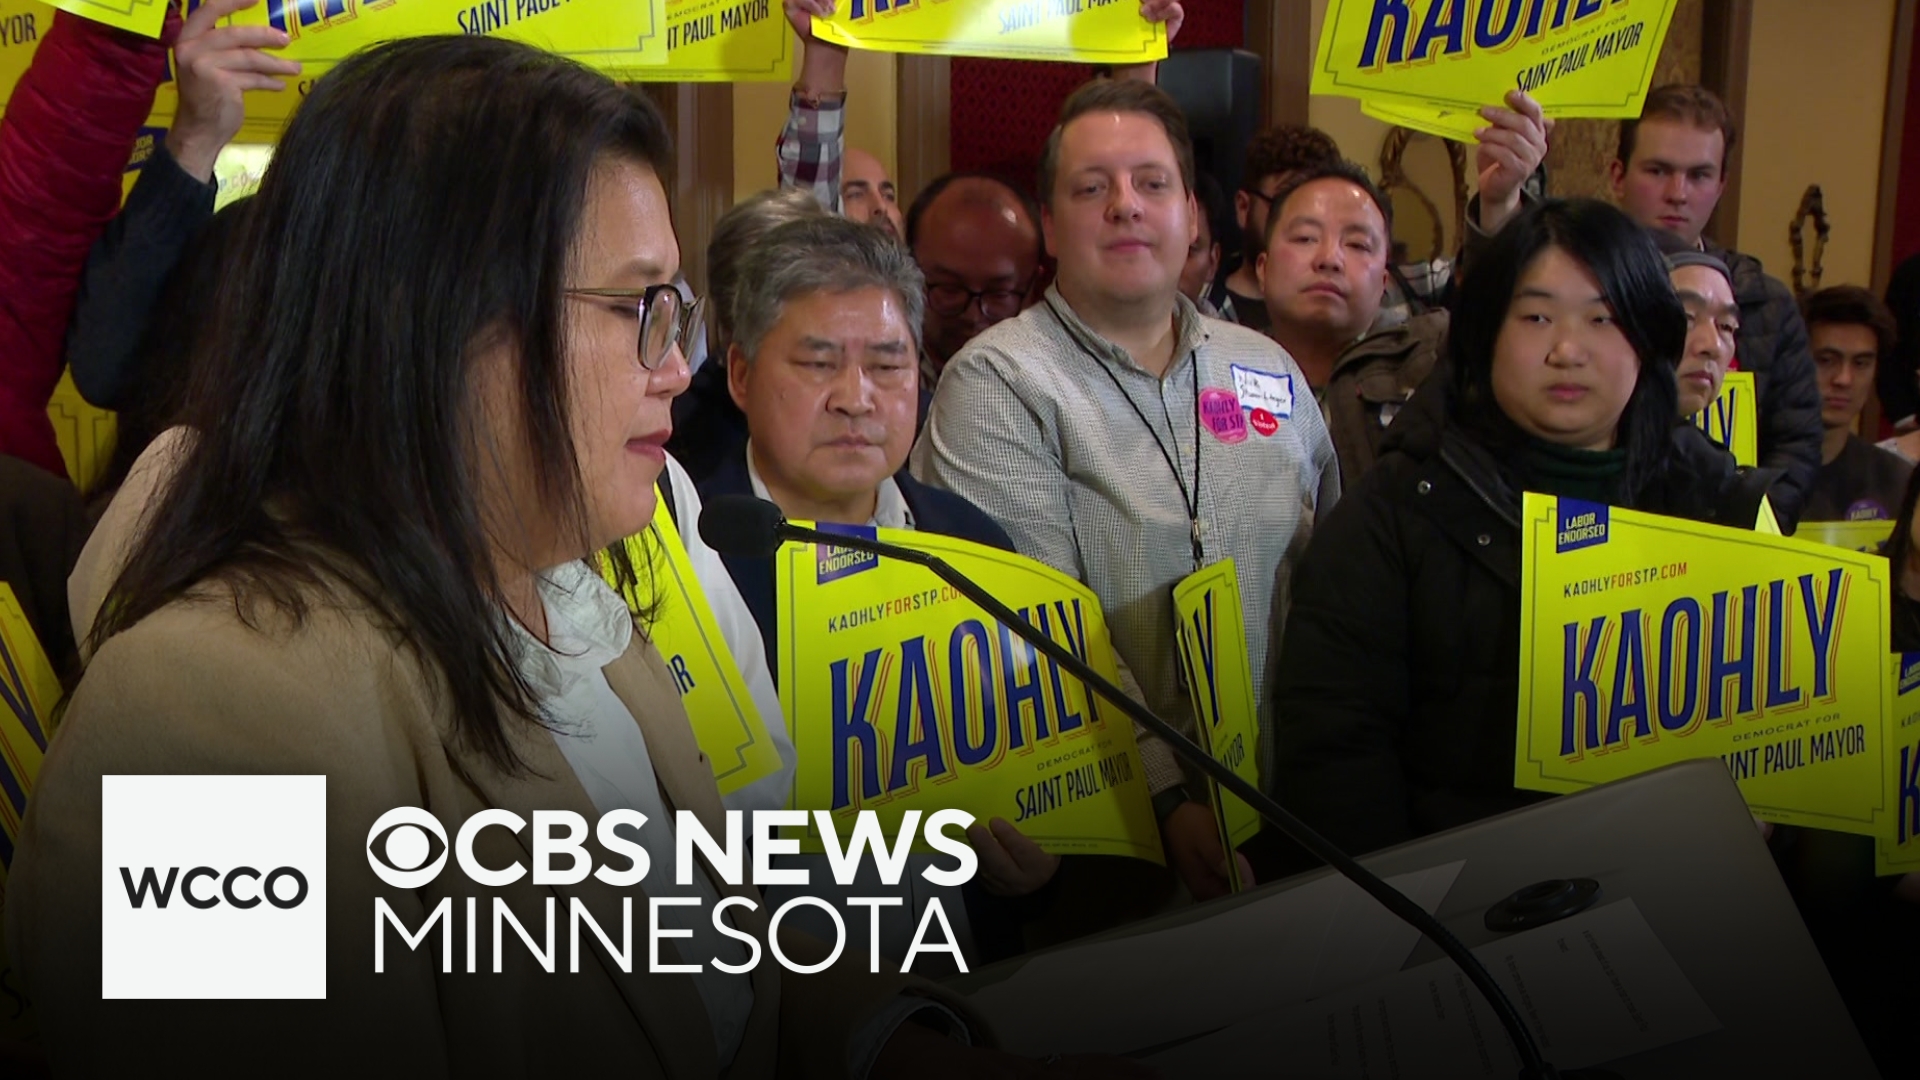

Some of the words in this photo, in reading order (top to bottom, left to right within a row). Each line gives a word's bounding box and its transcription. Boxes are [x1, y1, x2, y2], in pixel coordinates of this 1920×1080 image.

[683, 14, 716, 46] PAUL
[720, 0, 769, 33] MAYOR
[1516, 58, 1557, 93] SAINT
[1555, 43, 1590, 79] PAUL
[1590, 21, 1644, 64] MAYOR
[1558, 524, 1606, 546] ENDORSED
[1566, 513, 1596, 530] LABOR
[1563, 562, 1688, 599] KAOHLYFORSTP.COM
[828, 586, 963, 634] KAOHLYFORSTP.CO
[1559, 567, 1846, 758] KAOHLY
[829, 598, 1102, 812] KAOHLY
[1732, 719, 1811, 743] DEMOCRAT
[1815, 712, 1841, 725] FOR
[1764, 737, 1805, 775] PAUL
[1810, 724, 1866, 765] MAYOR
[1014, 775, 1063, 822] SAINT
[1065, 763, 1101, 803] PAUL
